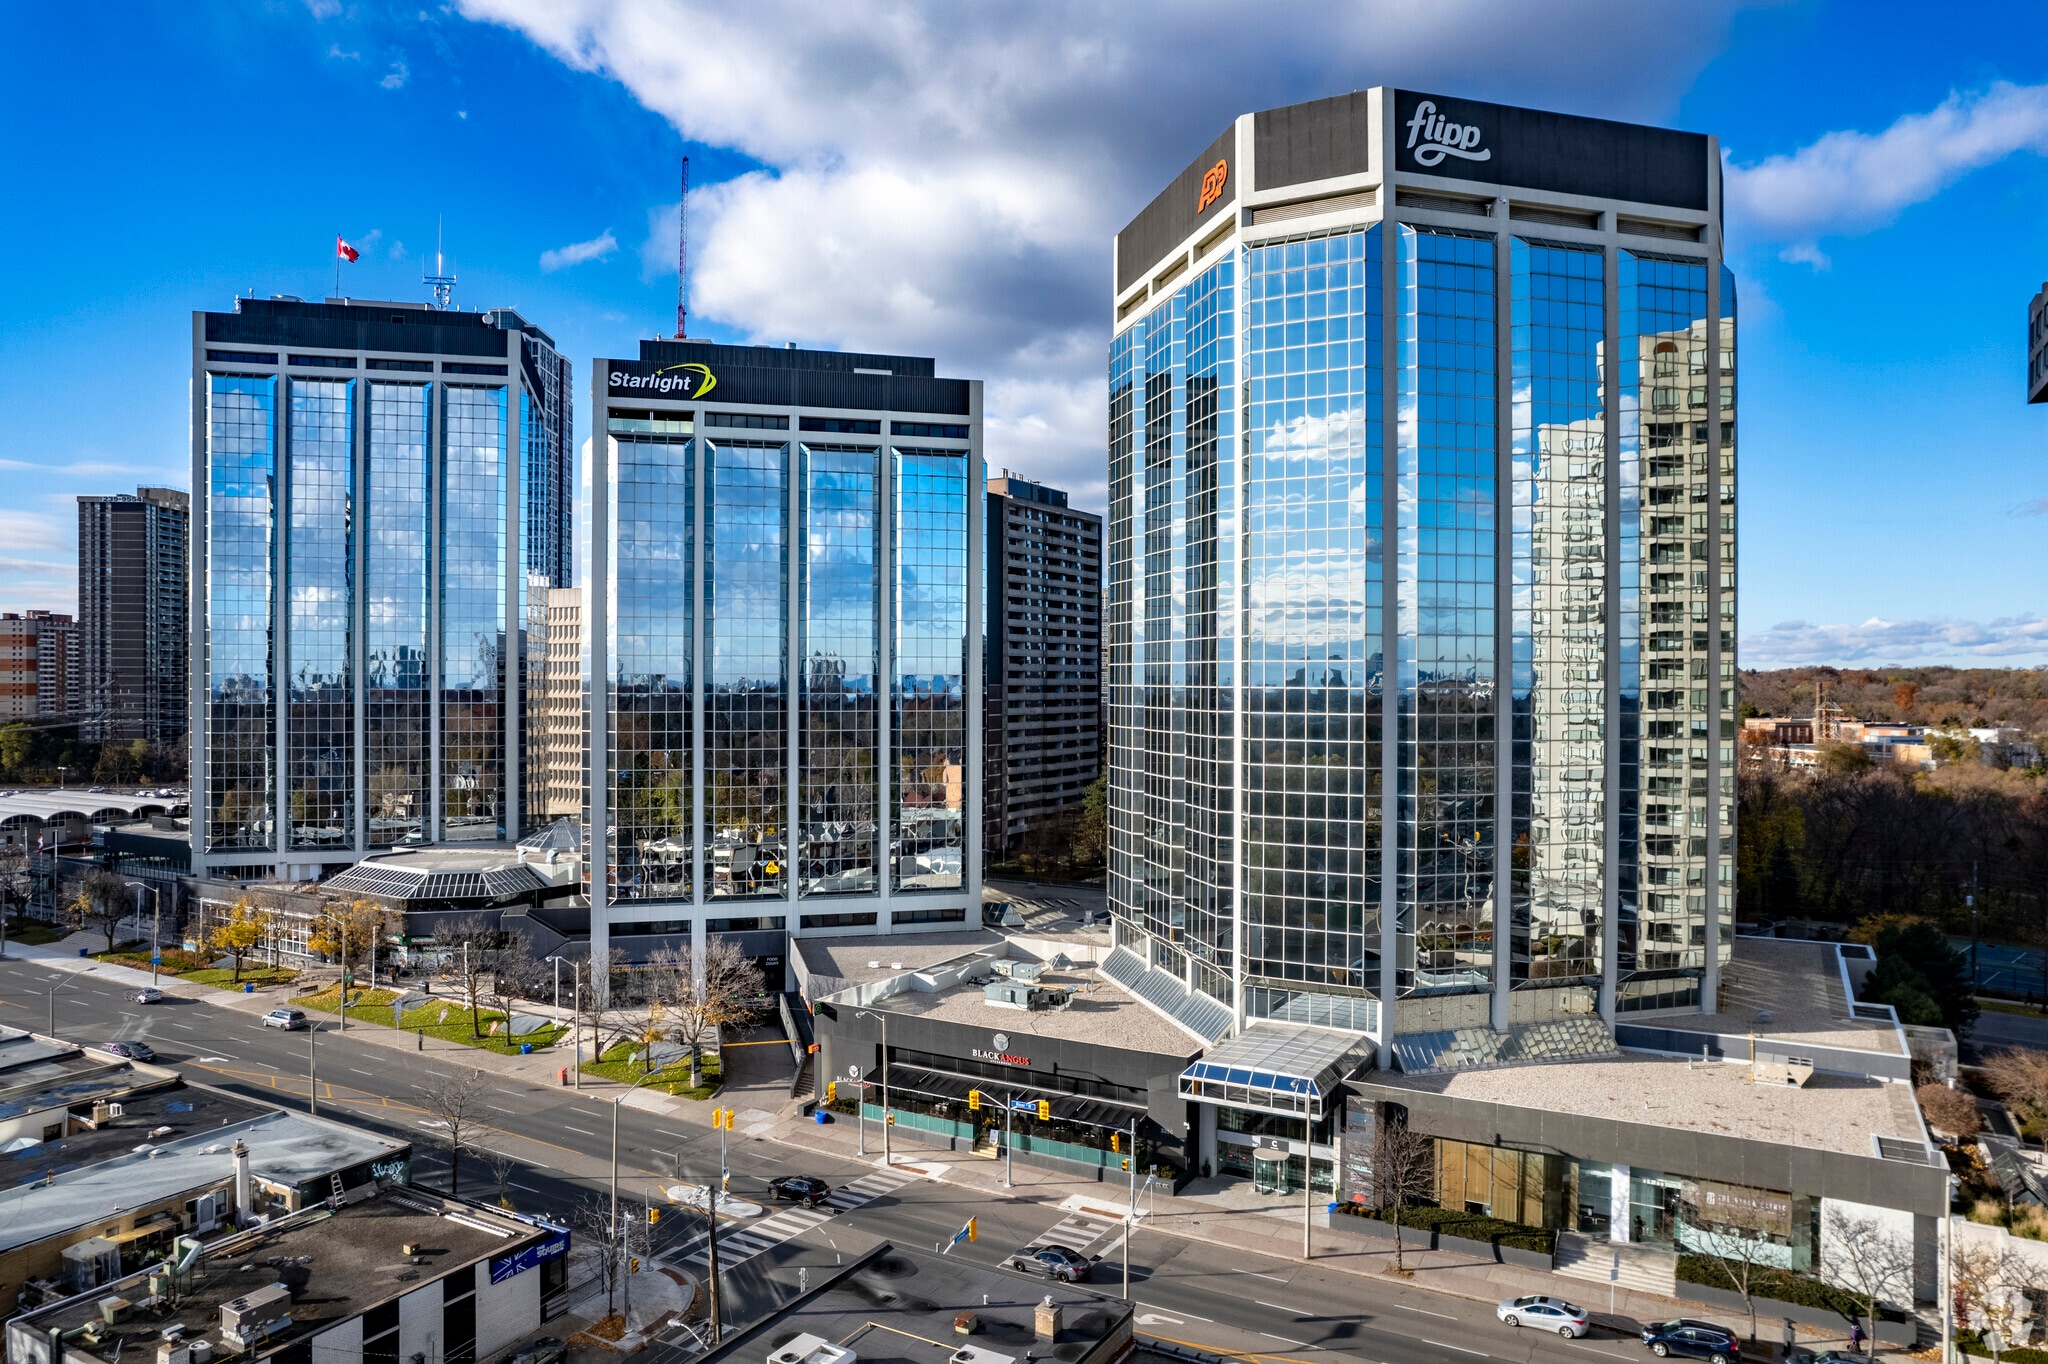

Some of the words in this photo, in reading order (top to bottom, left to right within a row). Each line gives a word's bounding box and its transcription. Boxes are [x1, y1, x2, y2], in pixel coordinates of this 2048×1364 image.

[1406, 101, 1491, 166] flipp
[1197, 160, 1228, 214] ADP
[609, 371, 691, 393] Starlight
[972, 1048, 1000, 1060] BLACK
[1000, 1053, 1030, 1066] ANGUS
[536, 1239, 565, 1258] SQUIRE
